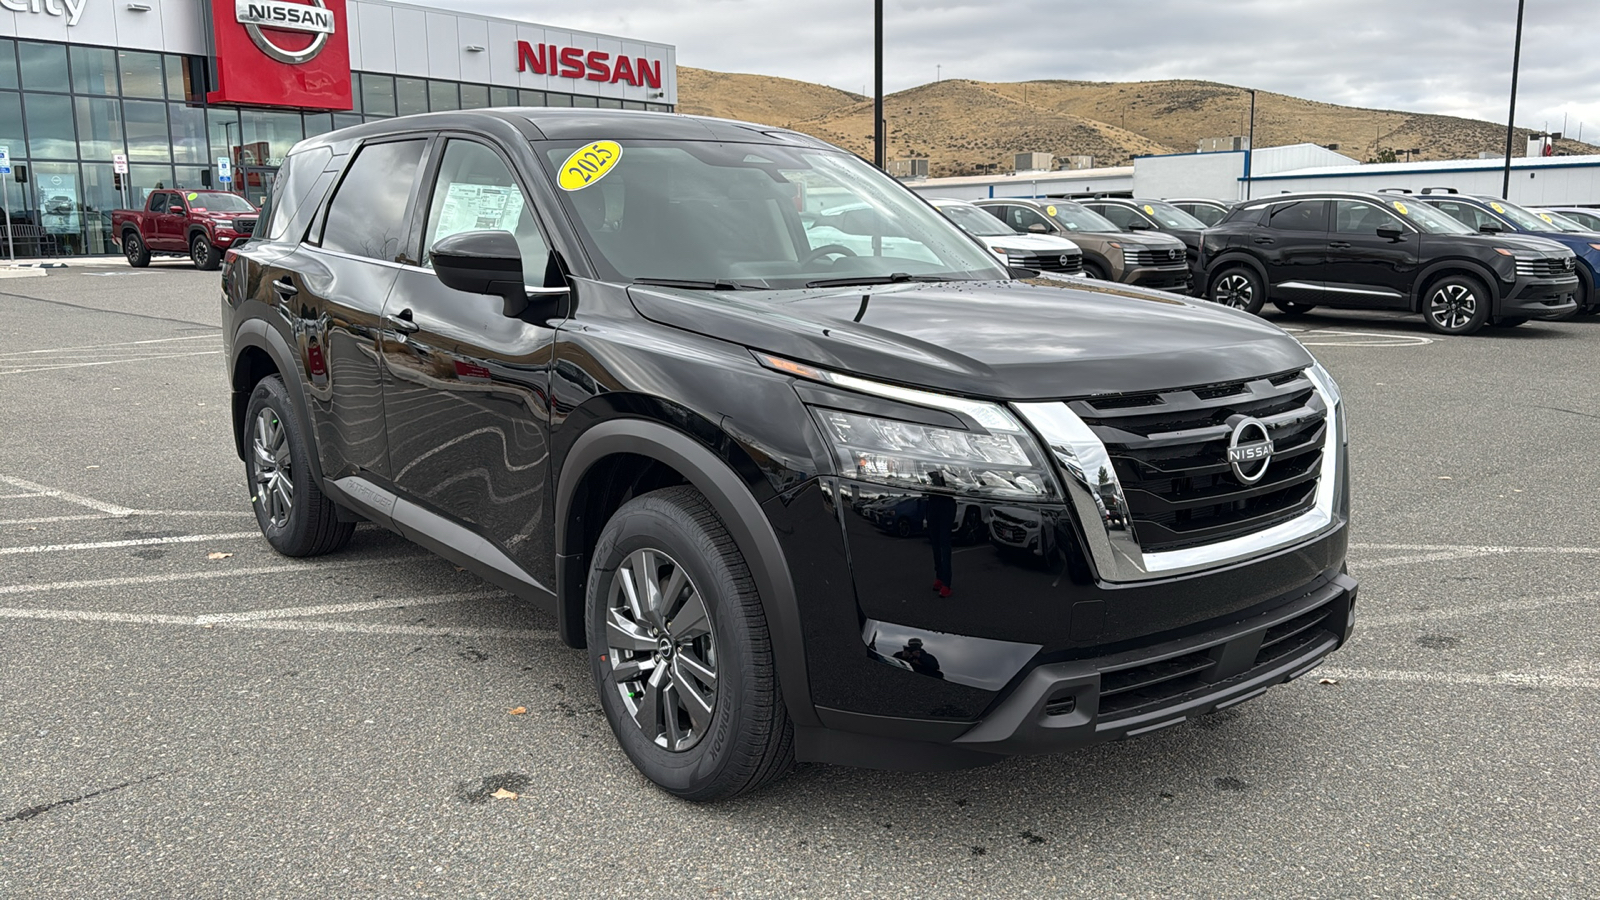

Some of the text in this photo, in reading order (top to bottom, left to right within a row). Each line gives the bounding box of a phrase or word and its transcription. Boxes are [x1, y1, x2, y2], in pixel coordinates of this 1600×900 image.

[248, 4, 328, 27] NISSAN
[517, 40, 661, 89] NISSAN
[569, 144, 613, 182] 2025
[1229, 443, 1274, 461] NISSAN
